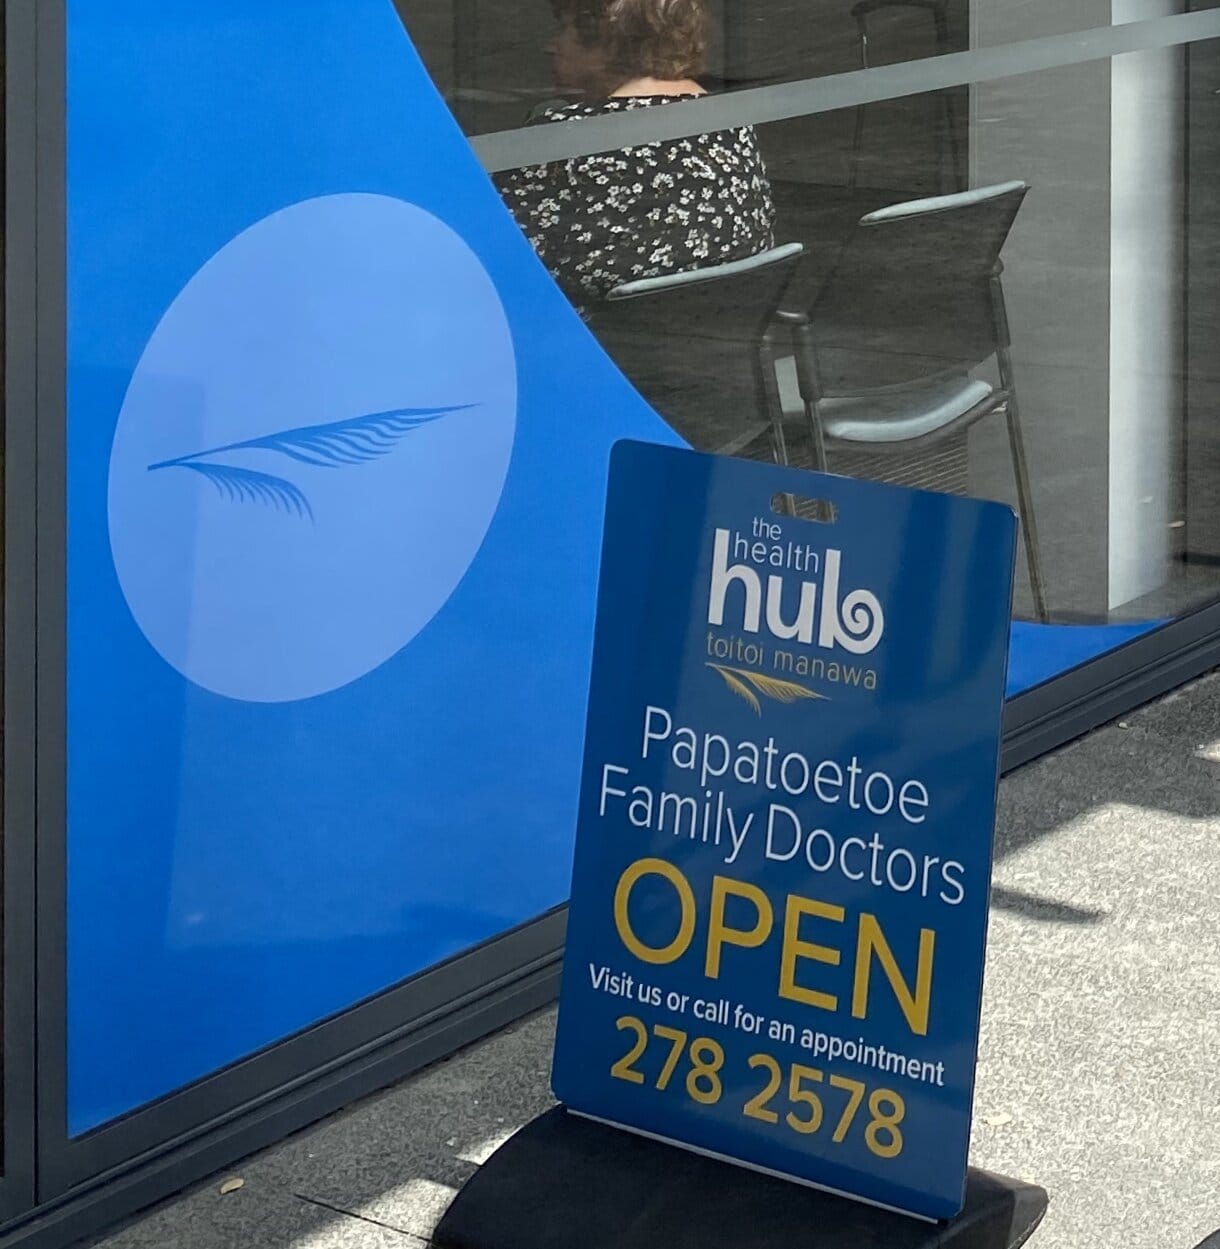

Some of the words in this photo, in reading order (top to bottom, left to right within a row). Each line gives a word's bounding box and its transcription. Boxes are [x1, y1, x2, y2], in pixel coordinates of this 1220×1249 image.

[734, 532, 819, 574] health
[752, 516, 782, 541] the
[708, 528, 884, 655] hub
[706, 631, 763, 666] toitoi
[773, 650, 877, 690] manawa
[641, 705, 929, 824] Papatoetoe
[599, 763, 754, 864] Family
[765, 803, 965, 905] Doctors
[613, 857, 936, 1037] OPEN
[589, 963, 633, 999] Visit
[637, 981, 662, 1007] us
[666, 991, 689, 1014] or
[693, 998, 729, 1026] call
[734, 1004, 765, 1035] for
[768, 1020, 795, 1044] an
[799, 1026, 945, 1087] appointment
[609, 1015, 725, 1105] 278
[743, 1053, 906, 1160] 2578
